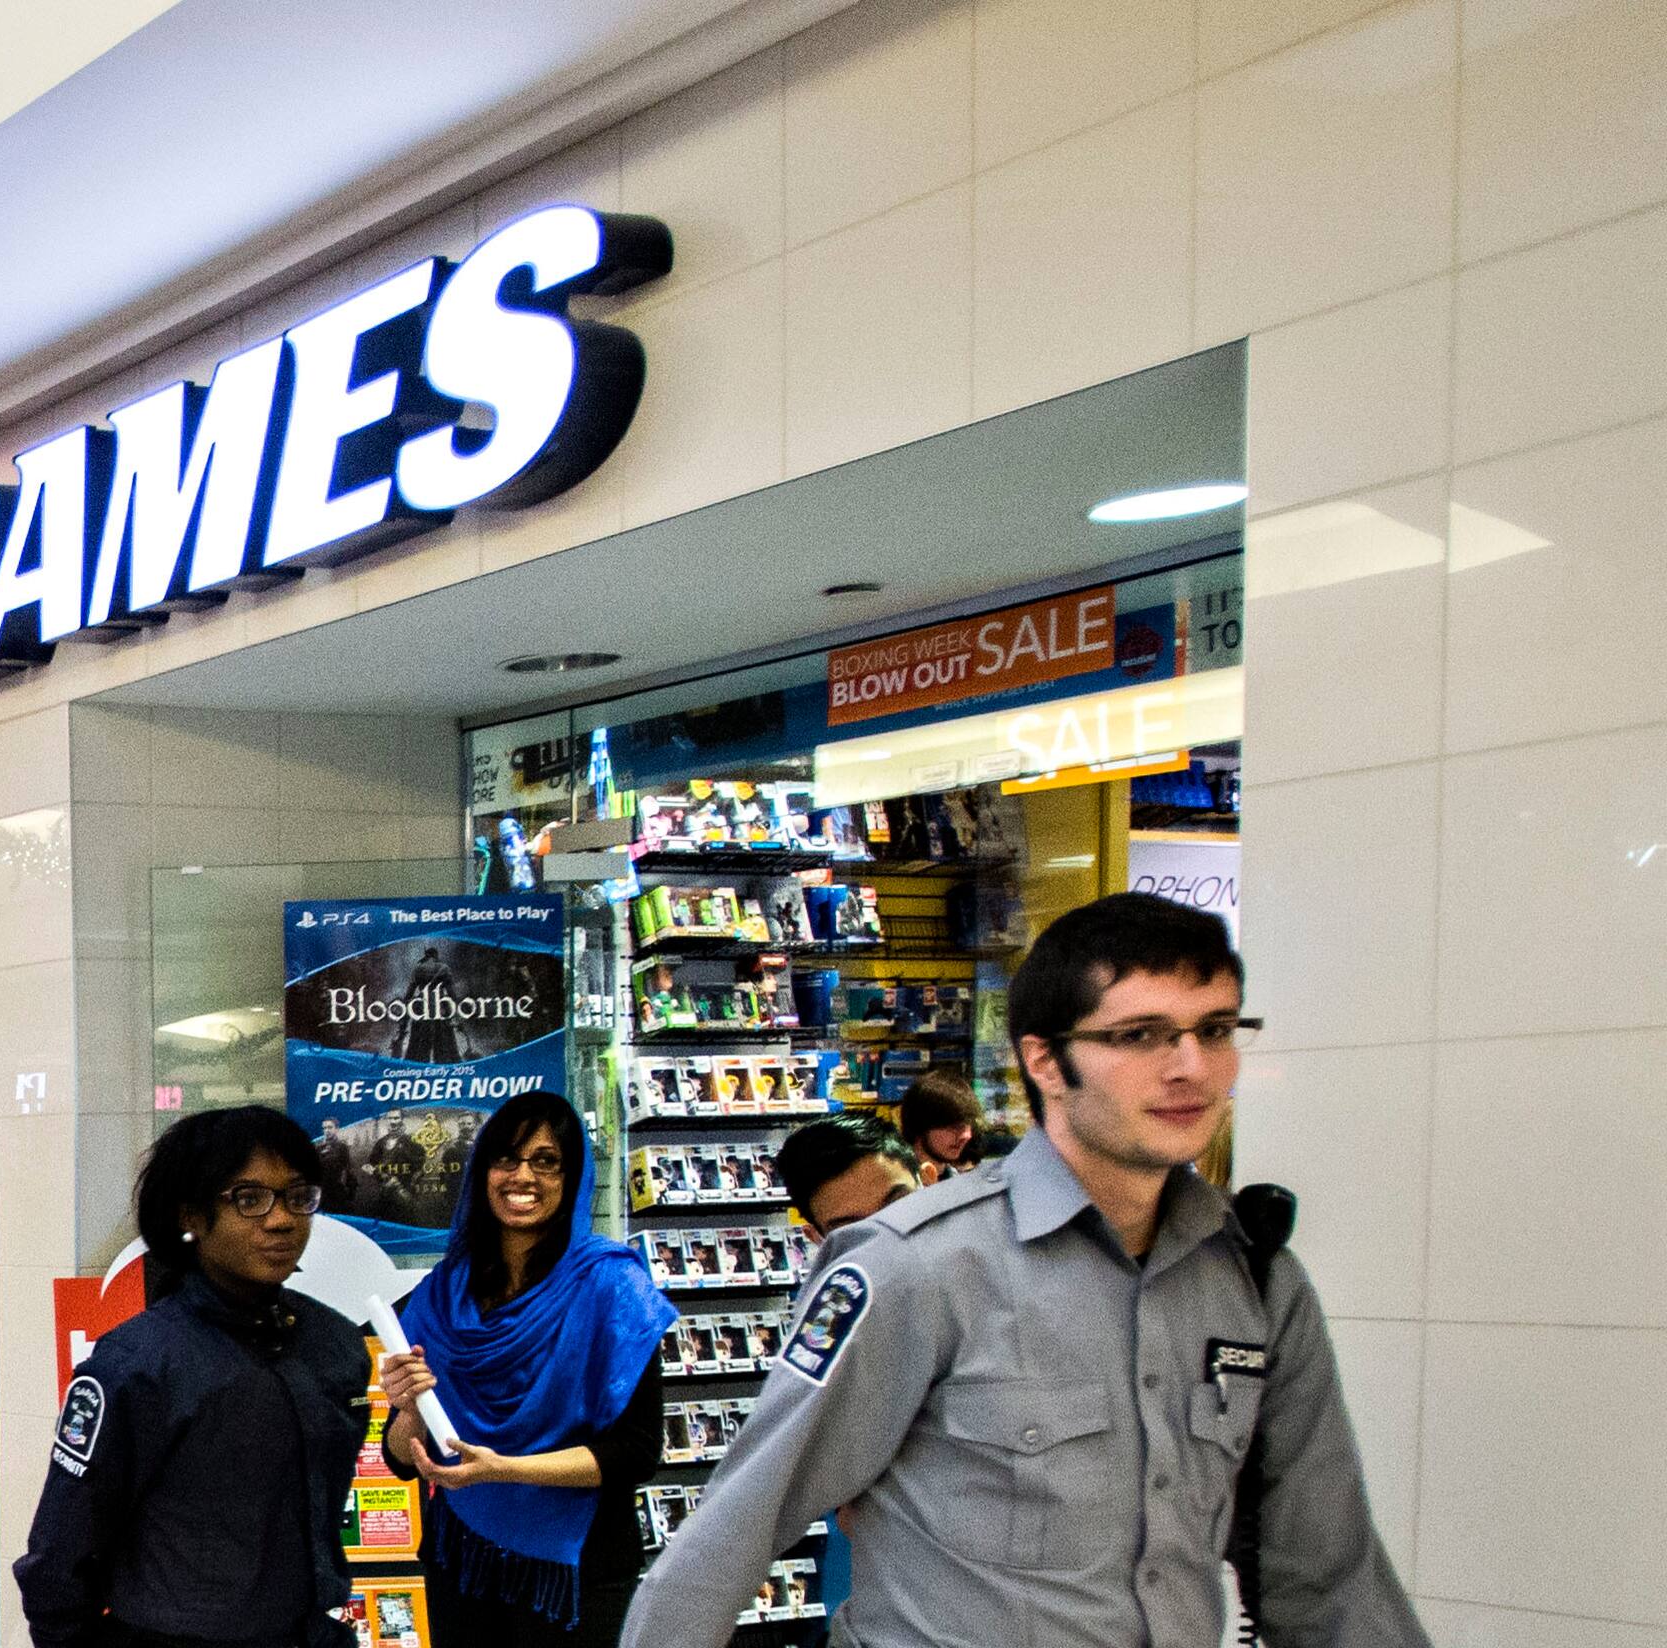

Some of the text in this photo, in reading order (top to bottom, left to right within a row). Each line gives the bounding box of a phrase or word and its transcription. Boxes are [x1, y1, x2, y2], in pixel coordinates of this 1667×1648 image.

[832, 628, 971, 681] BOXING WEEK
[977, 596, 1110, 676] SALE
[831, 653, 972, 708] BLOW OUT
[1008, 693, 1179, 784] SALE
[390, 910, 418, 922] The
[421, 909, 454, 922] Best
[457, 908, 496, 921] Place
[498, 908, 514, 920] to
[319, 982, 534, 1027] Bloodborne
[315, 1079, 463, 1104] PRE-ORDER
[377, 1161, 412, 1175] THE
